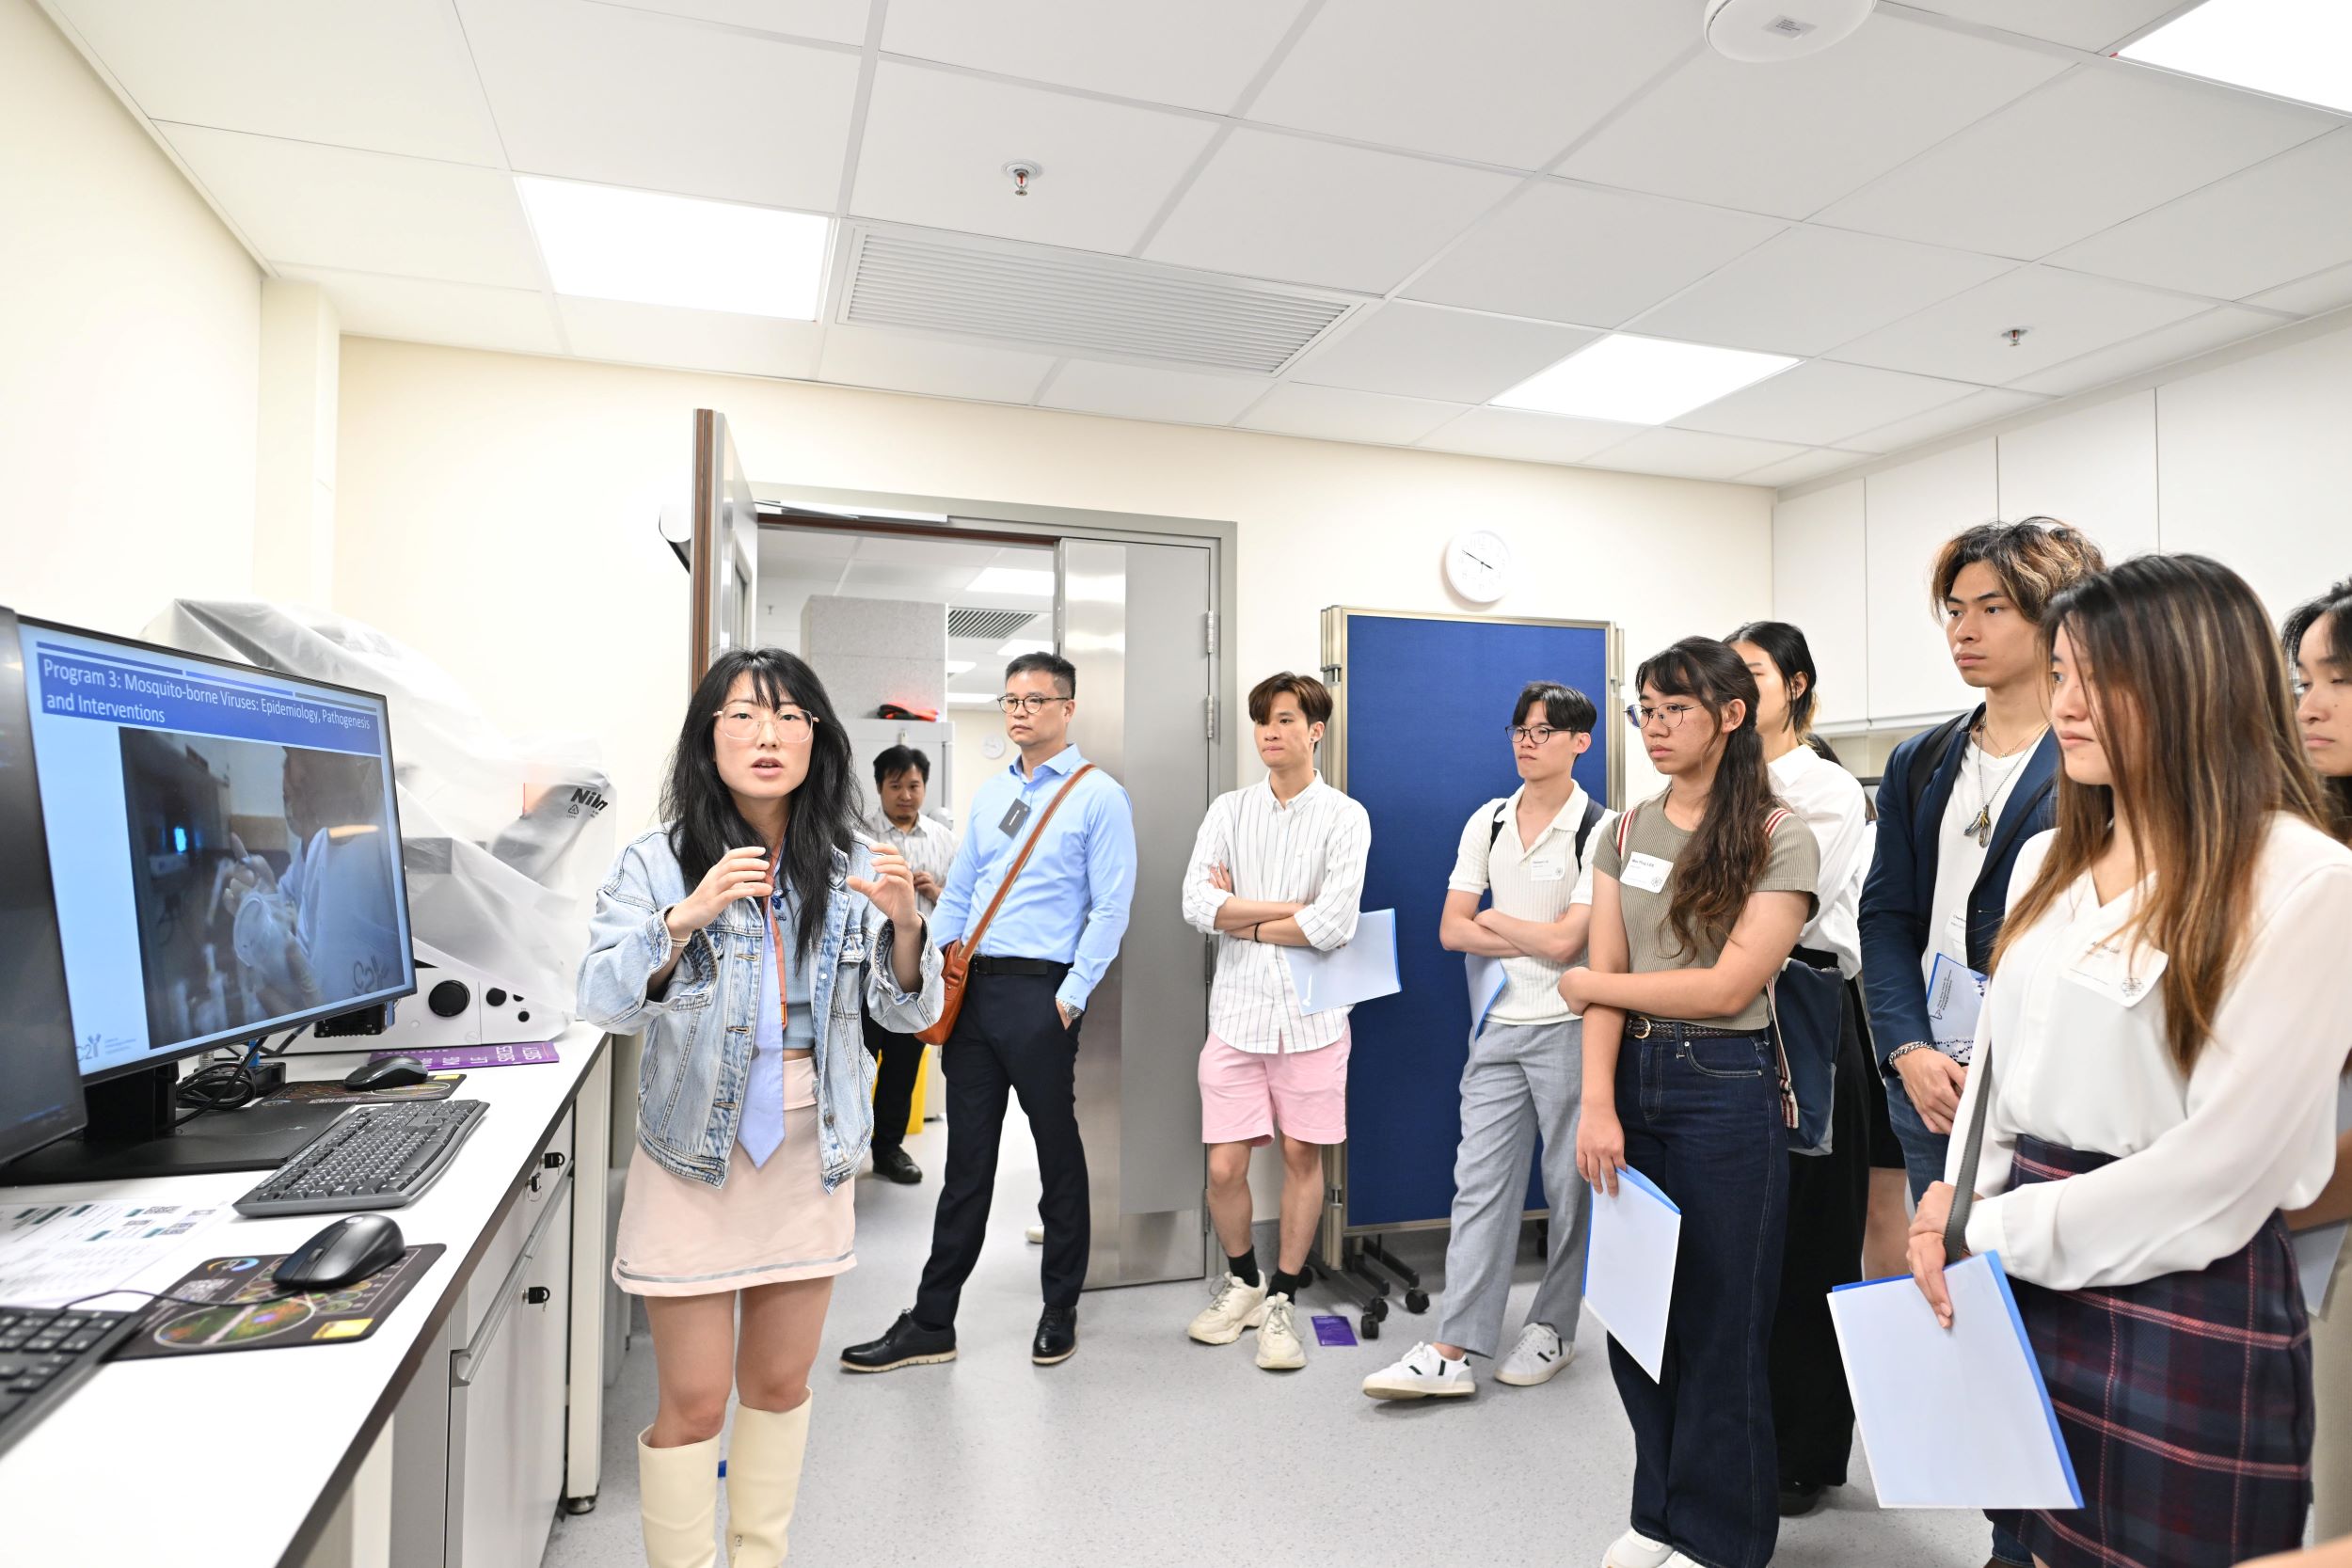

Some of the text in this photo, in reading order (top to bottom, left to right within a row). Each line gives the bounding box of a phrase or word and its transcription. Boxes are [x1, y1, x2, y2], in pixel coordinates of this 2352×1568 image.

[43, 659, 371, 730] Program 3: Mosquito-borne Viruses: Epidemiology, Pathogenesis
[47, 692, 166, 723] and Interventions
